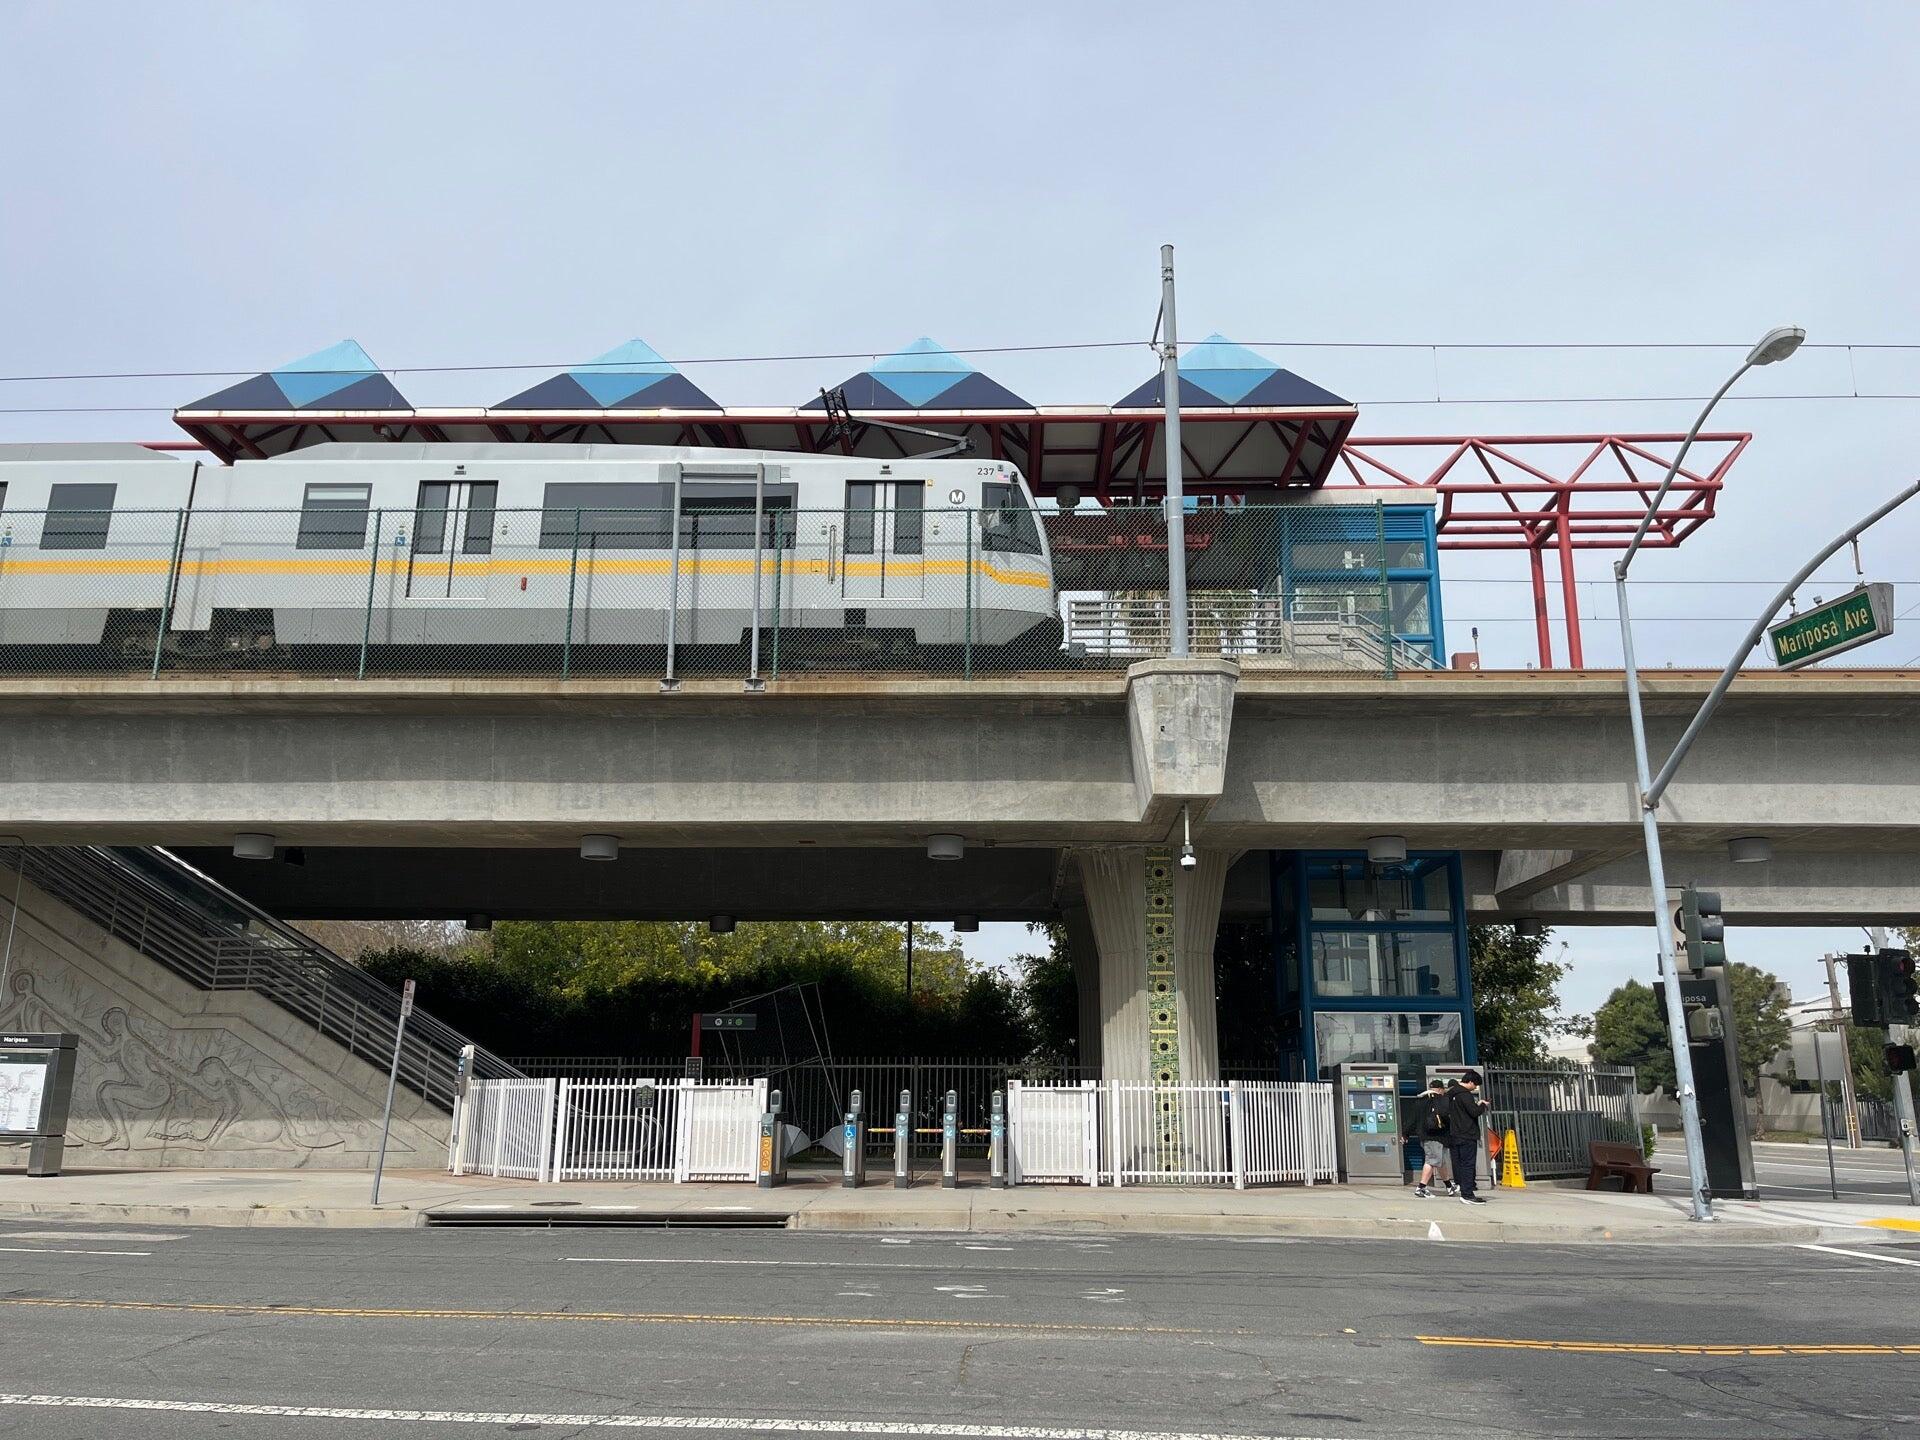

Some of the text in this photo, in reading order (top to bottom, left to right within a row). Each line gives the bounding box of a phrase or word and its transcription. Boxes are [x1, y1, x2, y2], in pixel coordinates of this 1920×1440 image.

[978, 468, 994, 476] 237
[1777, 607, 1869, 657] Mariposa Ave
[1682, 994, 1706, 1003] iposa
